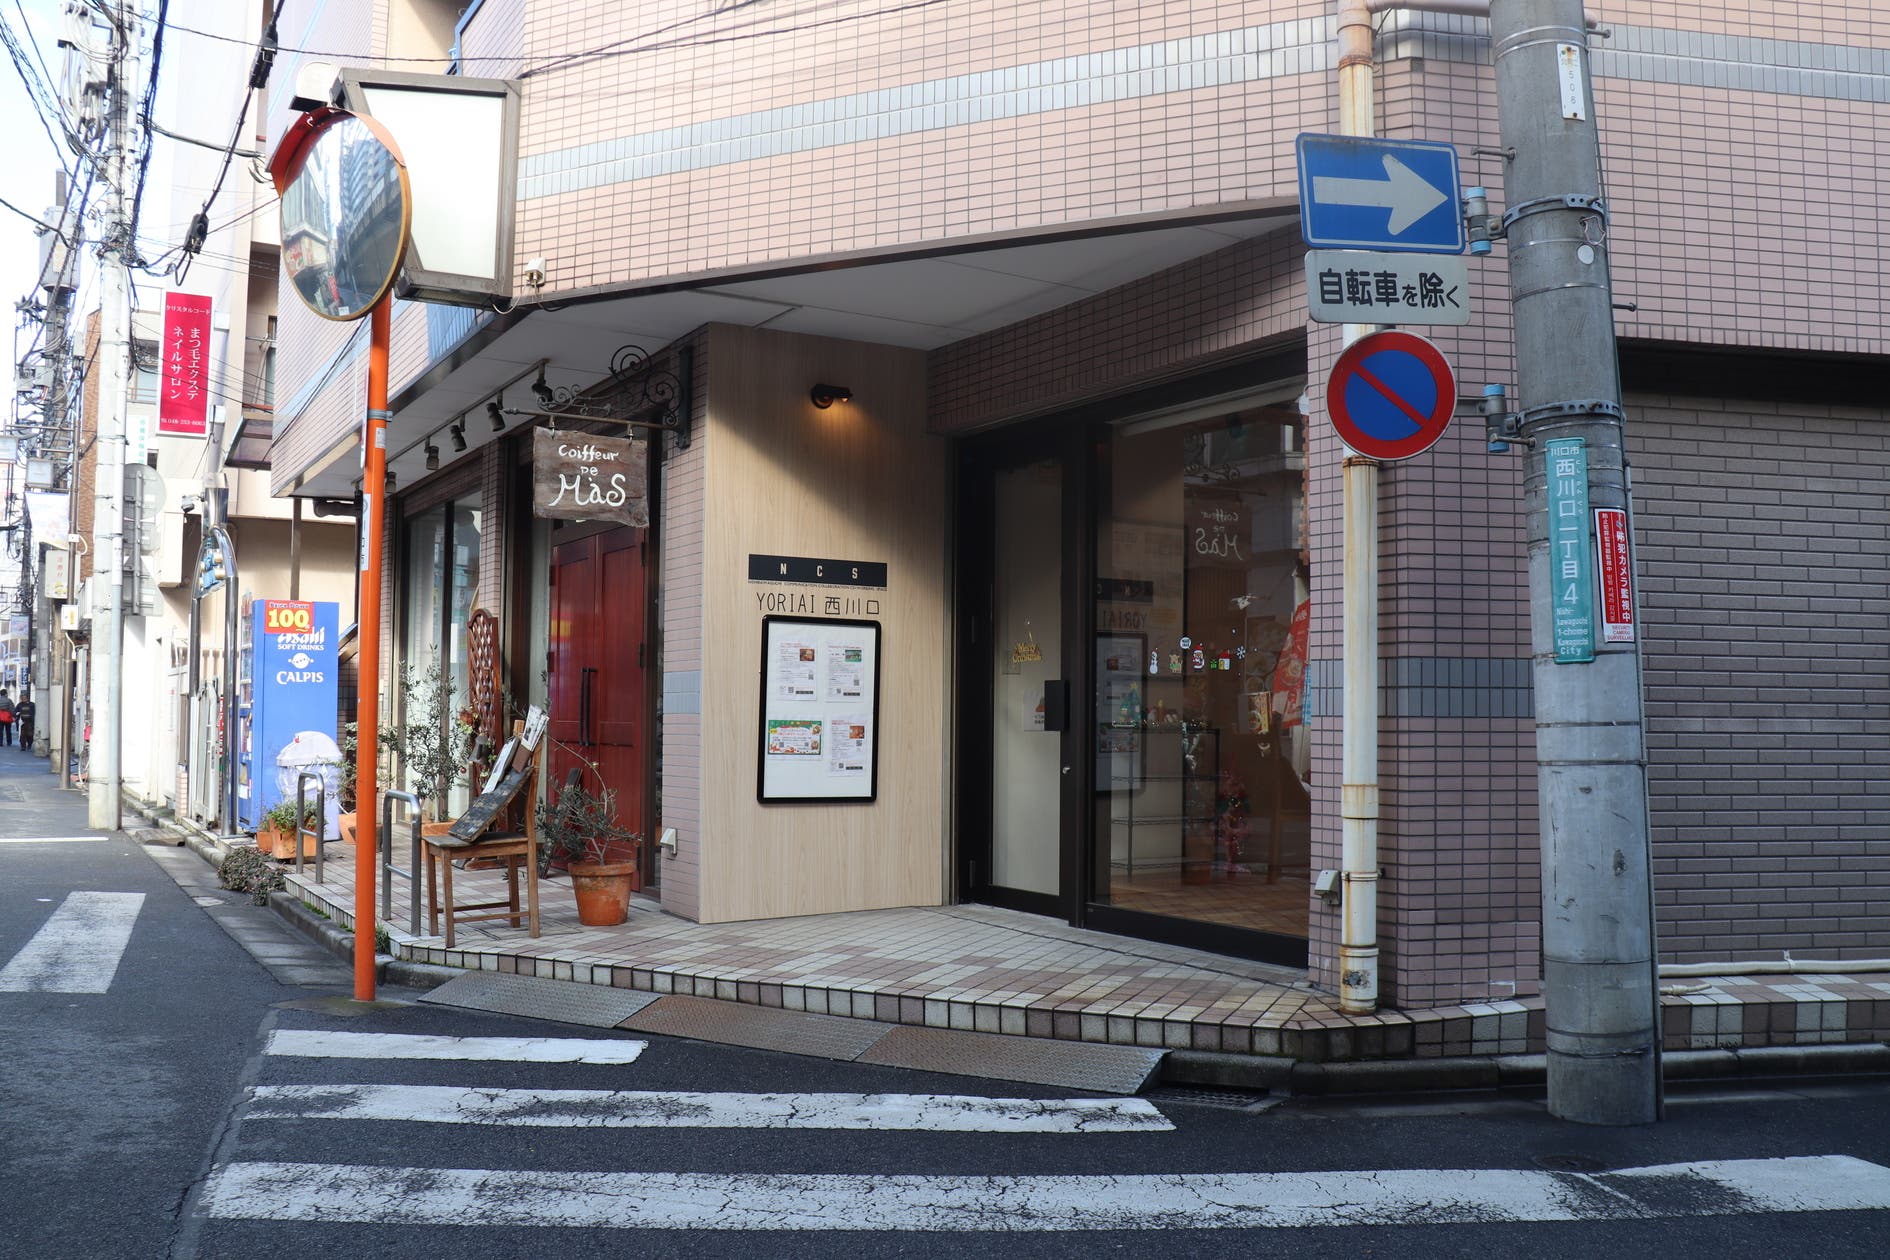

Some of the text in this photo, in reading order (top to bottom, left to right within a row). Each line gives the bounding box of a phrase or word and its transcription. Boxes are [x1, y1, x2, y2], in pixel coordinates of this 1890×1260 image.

[1319, 268, 1460, 308] 自転車を除く
[171, 326, 184, 400] ネイルサロン
[187, 328, 201, 400] まつ毛エクステ
[558, 444, 619, 462] Coiffeur
[1550, 446, 1580, 456] 川口市
[1616, 530, 1631, 622] 防犯カメラ監視中
[756, 592, 880, 615] YORIAI 西川口
[268, 608, 309, 629] 100
[1560, 646, 1581, 656] City
[276, 671, 324, 685] CALPIS
